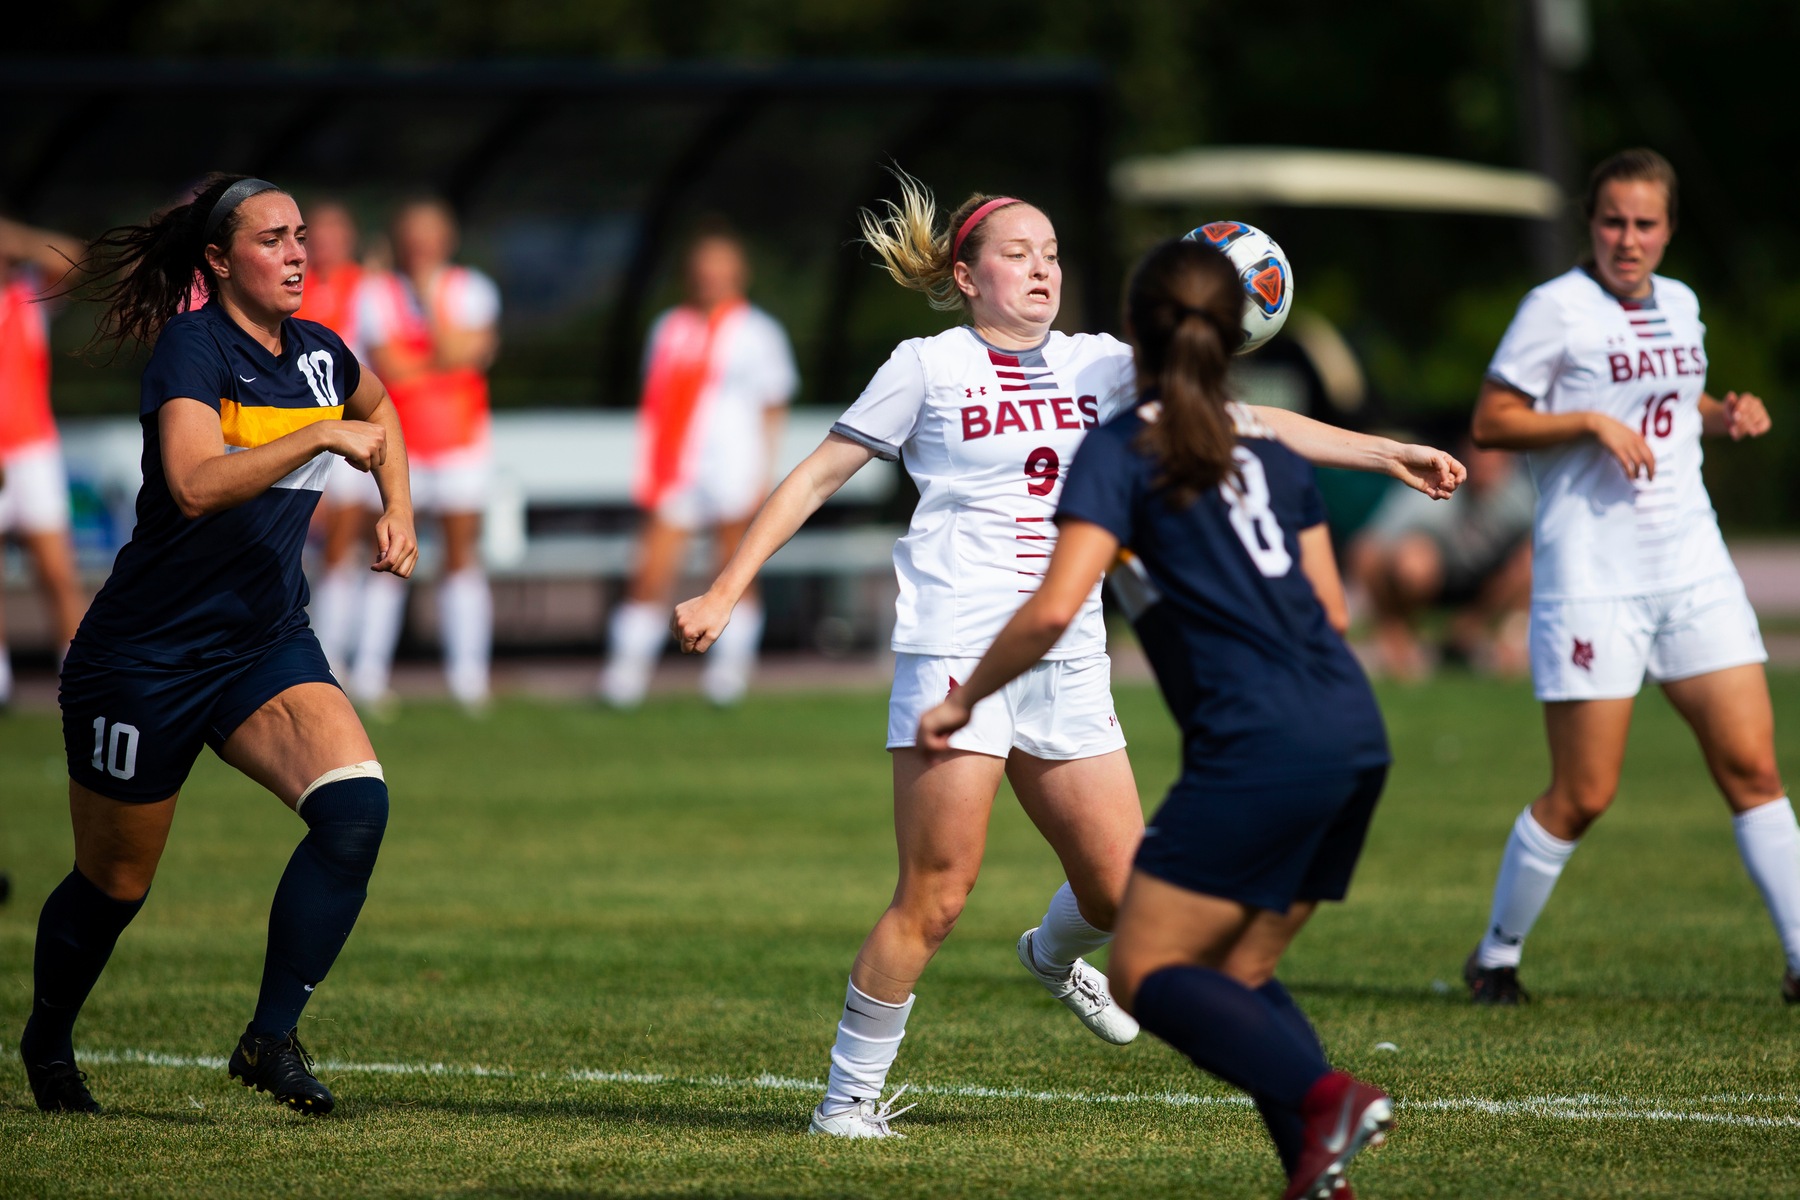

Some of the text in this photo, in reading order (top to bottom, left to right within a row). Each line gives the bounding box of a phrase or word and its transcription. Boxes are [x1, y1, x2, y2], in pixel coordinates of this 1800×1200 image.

[297, 350, 338, 406] 10
[1608, 346, 1704, 383] BATES
[961, 395, 1099, 442] BATES
[1641, 392, 1679, 438] 16
[1024, 447, 1060, 496] 9
[1219, 446, 1293, 577] 8
[91, 716, 140, 780] 10
